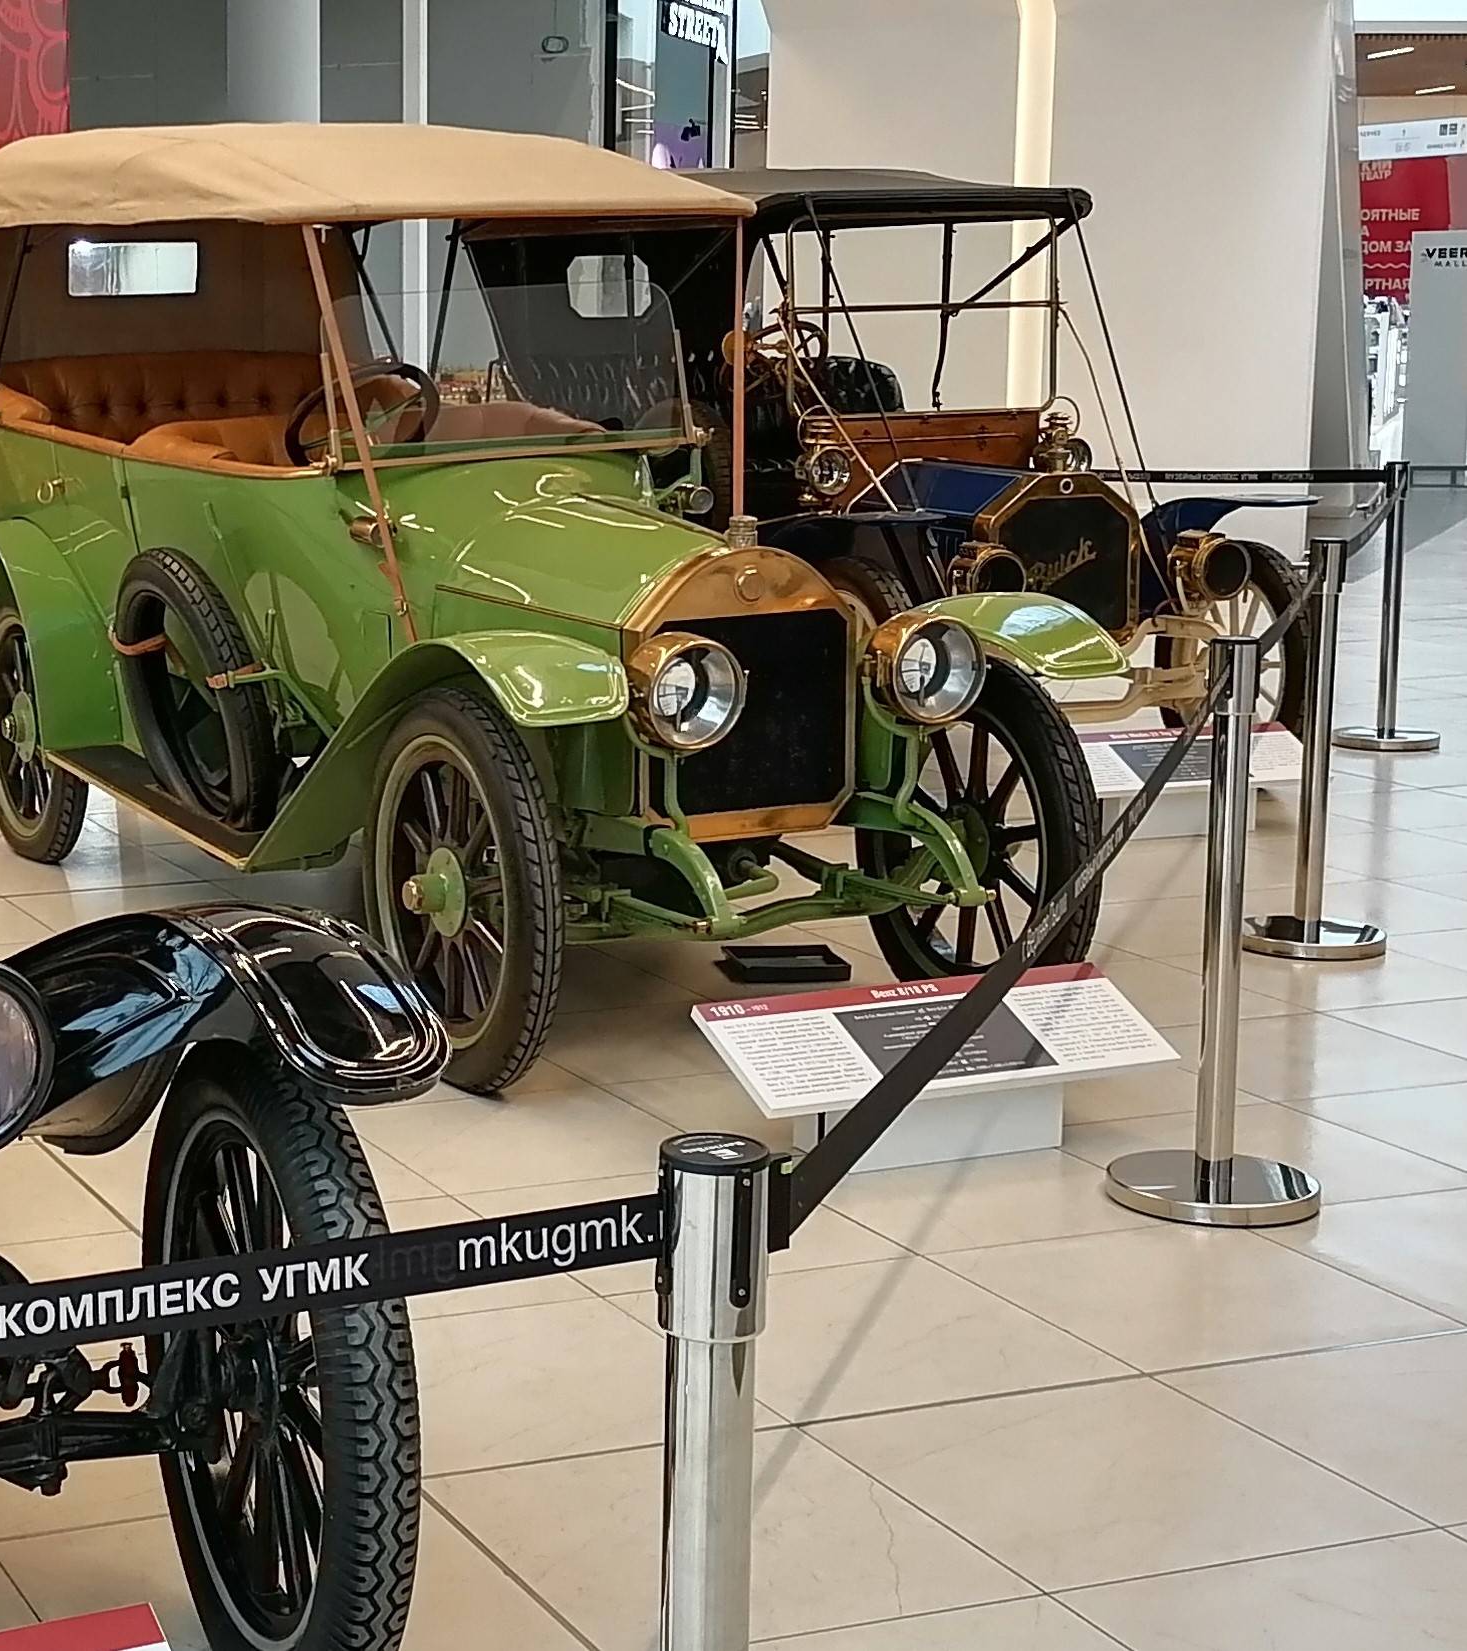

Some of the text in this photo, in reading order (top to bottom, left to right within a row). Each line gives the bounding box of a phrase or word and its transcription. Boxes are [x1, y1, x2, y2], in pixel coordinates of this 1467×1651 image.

[668, 2, 721, 48] STREET
[1028, 537, 1097, 592] Buick
[710, 1003, 745, 1017] 1910
[258, 1253, 371, 1302] УГМК
